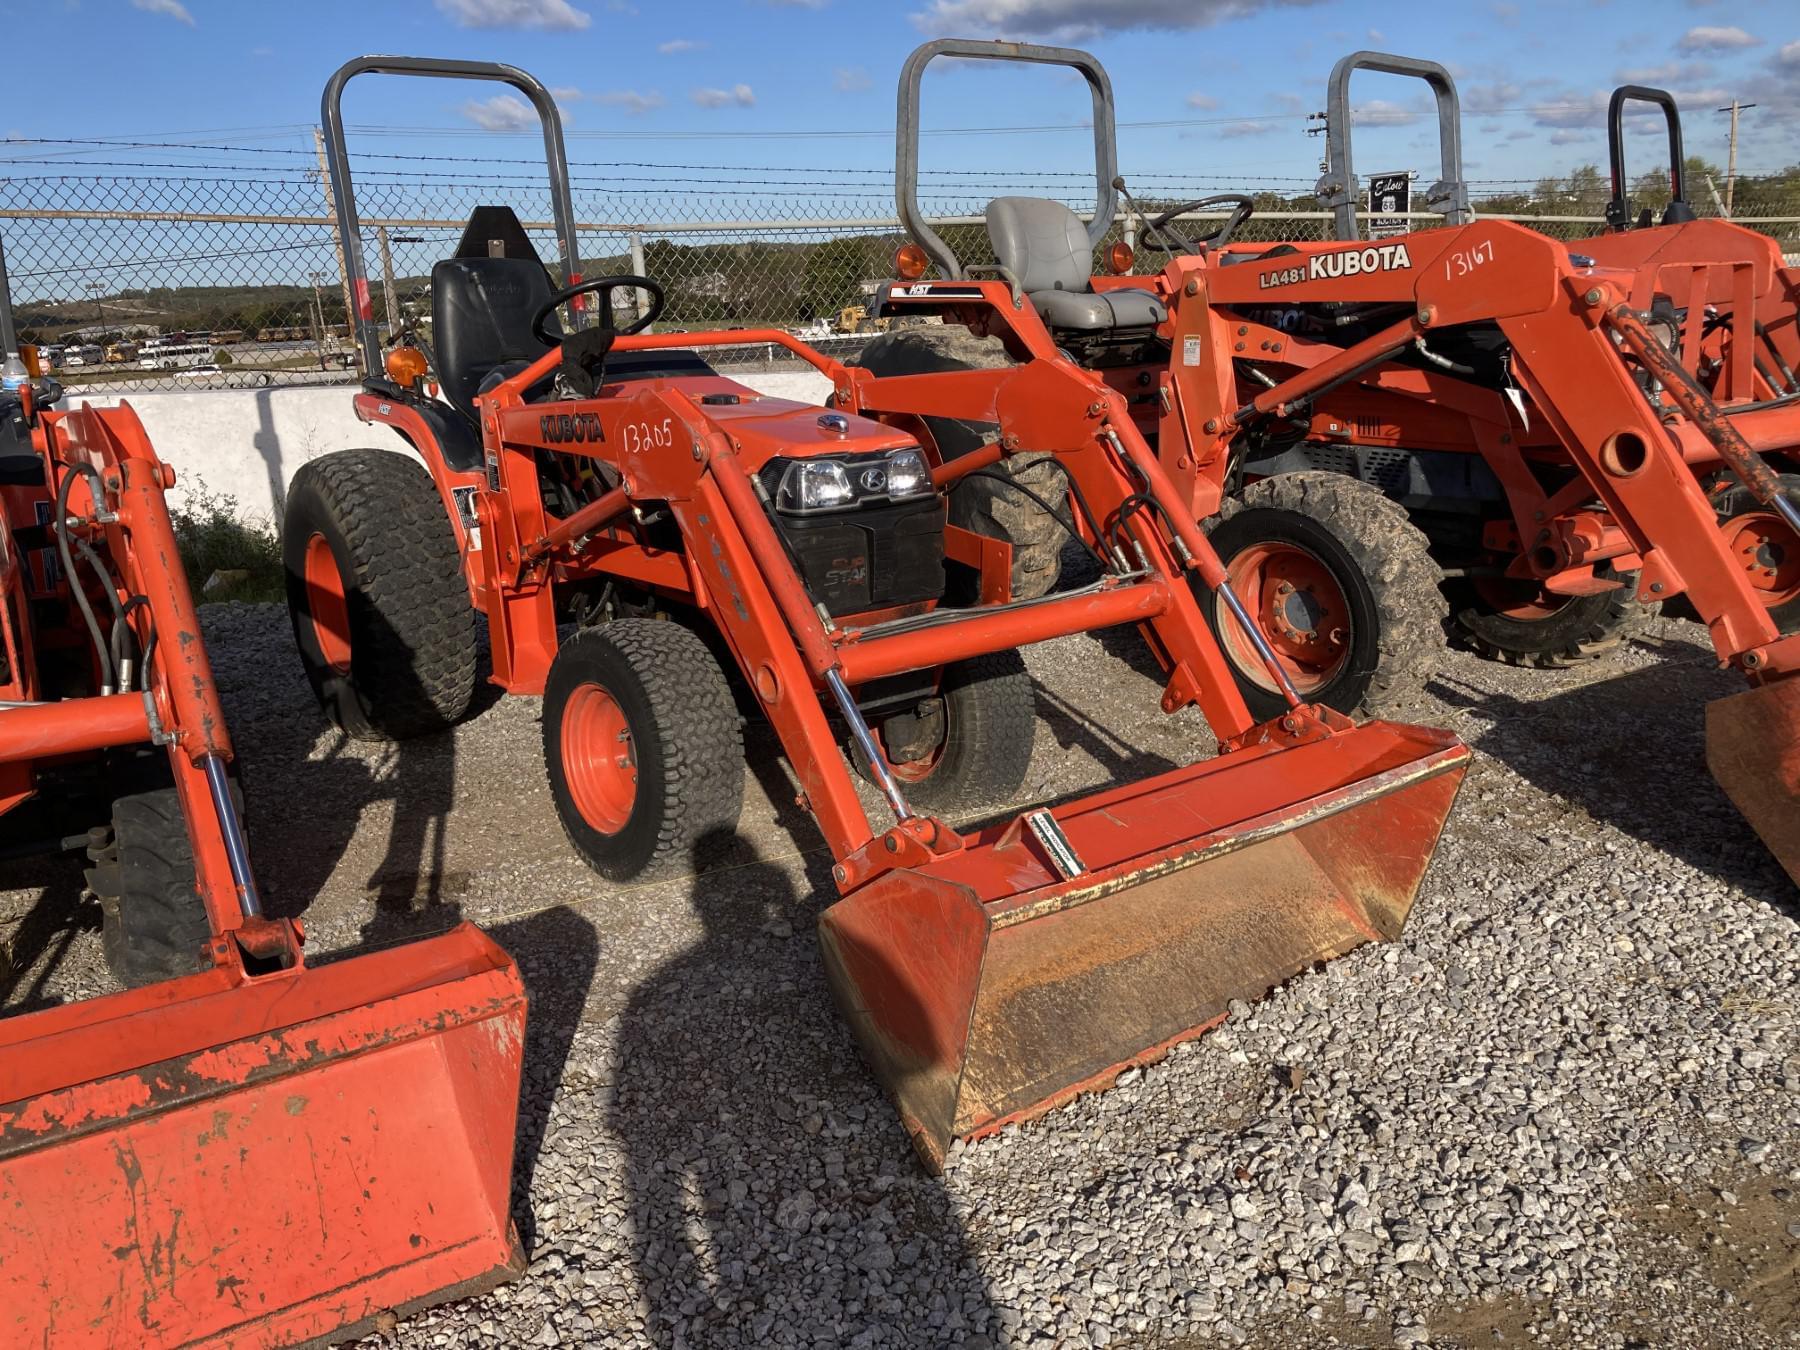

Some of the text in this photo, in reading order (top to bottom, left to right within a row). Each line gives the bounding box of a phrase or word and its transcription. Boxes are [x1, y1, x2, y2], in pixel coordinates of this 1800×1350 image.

[1383, 201, 1395, 211] 66
[1260, 243, 1412, 290] LA481 KUBOTA
[1445, 240, 1495, 281] 13167
[541, 412, 606, 444] KUBOTA
[623, 418, 672, 453] 13205
